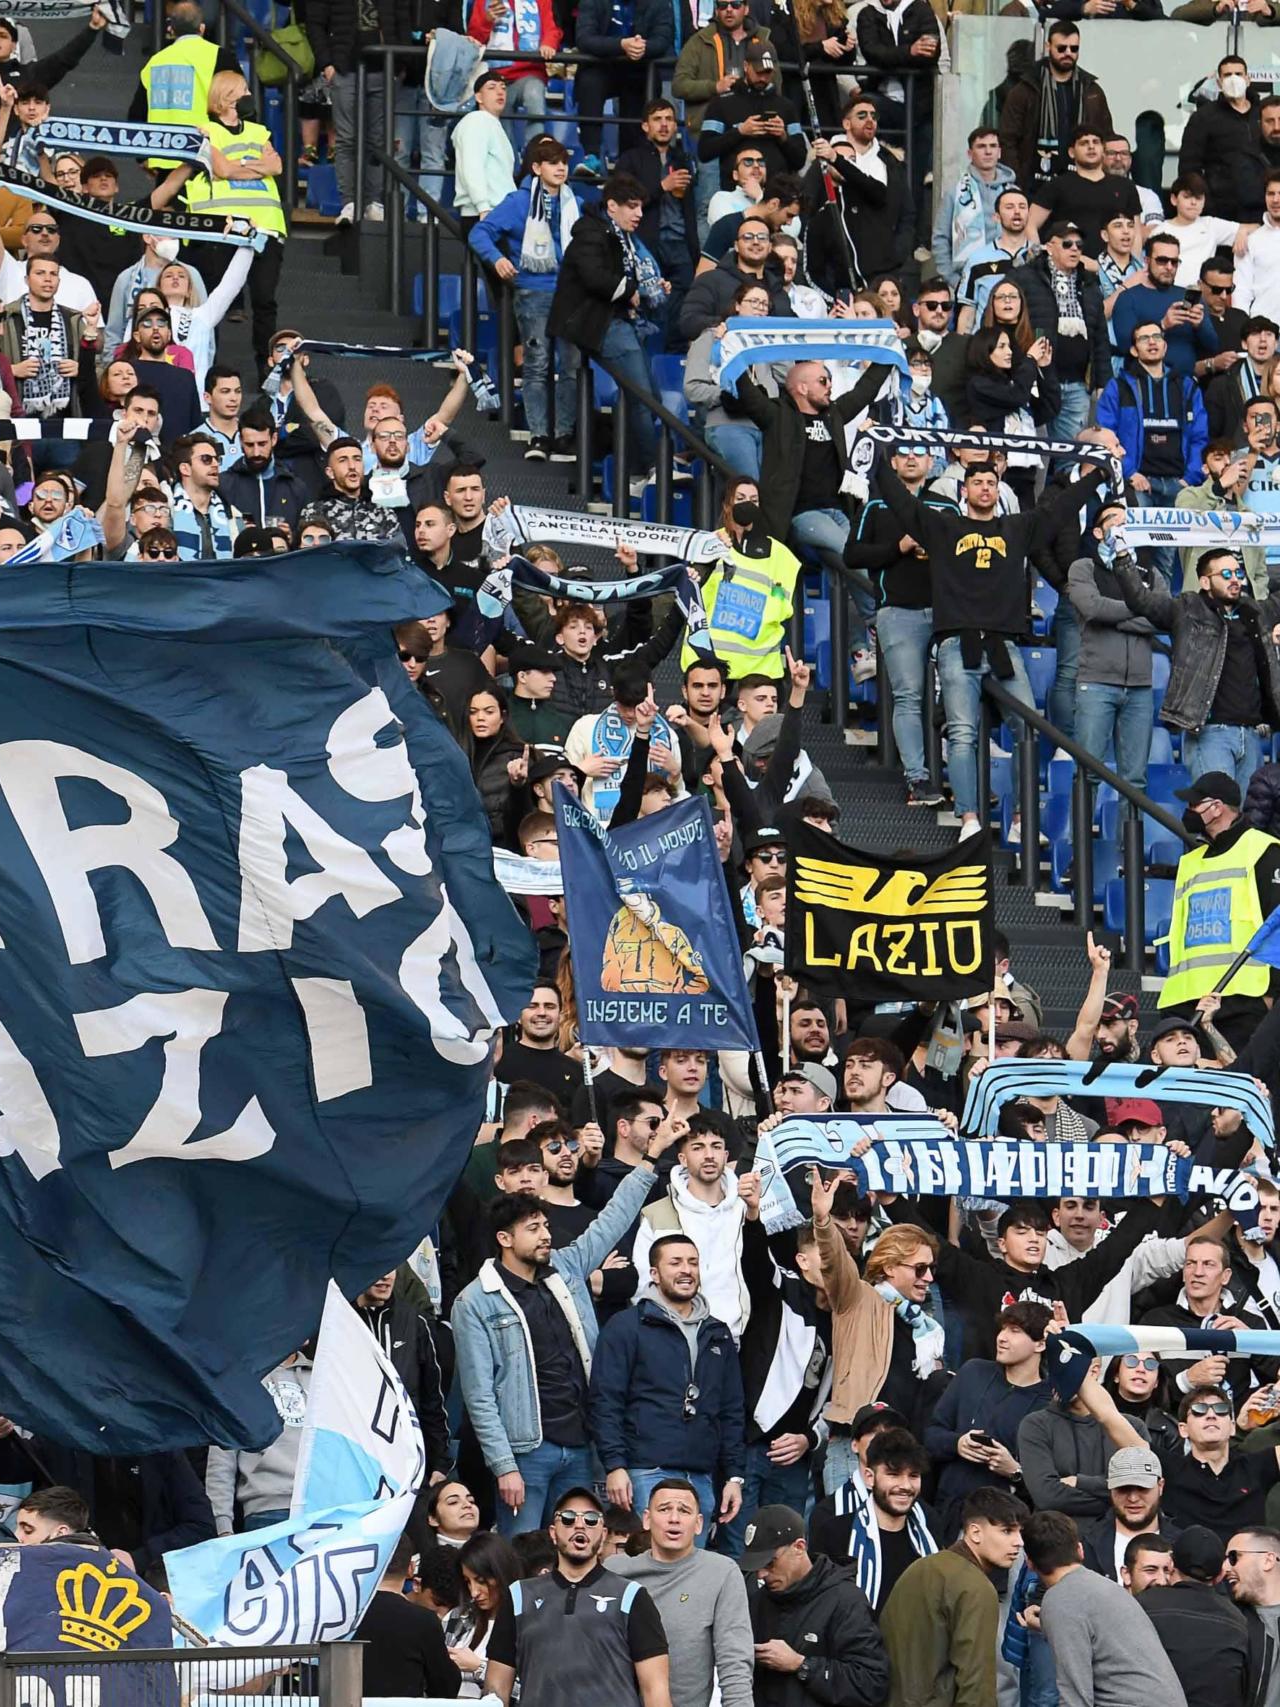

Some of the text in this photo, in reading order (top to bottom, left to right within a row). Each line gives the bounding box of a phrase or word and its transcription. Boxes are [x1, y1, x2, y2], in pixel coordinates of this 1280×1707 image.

[39, 121, 188, 150] FORZA LAZIO
[162, 213, 214, 229] 2020
[869, 425, 981, 445] CURVA
[527, 520, 609, 534] CANCELLA
[612, 527, 680, 544] L'ODORE
[545, 513, 633, 528] TRICOLORE
[975, 548, 992, 568] 12
[719, 584, 766, 613] STEWARD
[719, 614, 756, 632] 0547
[658, 818, 703, 854] MONDO
[805, 911, 982, 976] LAZIO
[586, 1000, 728, 1026] INSIEME A TE
[1167, 1151, 1177, 1193] macro
